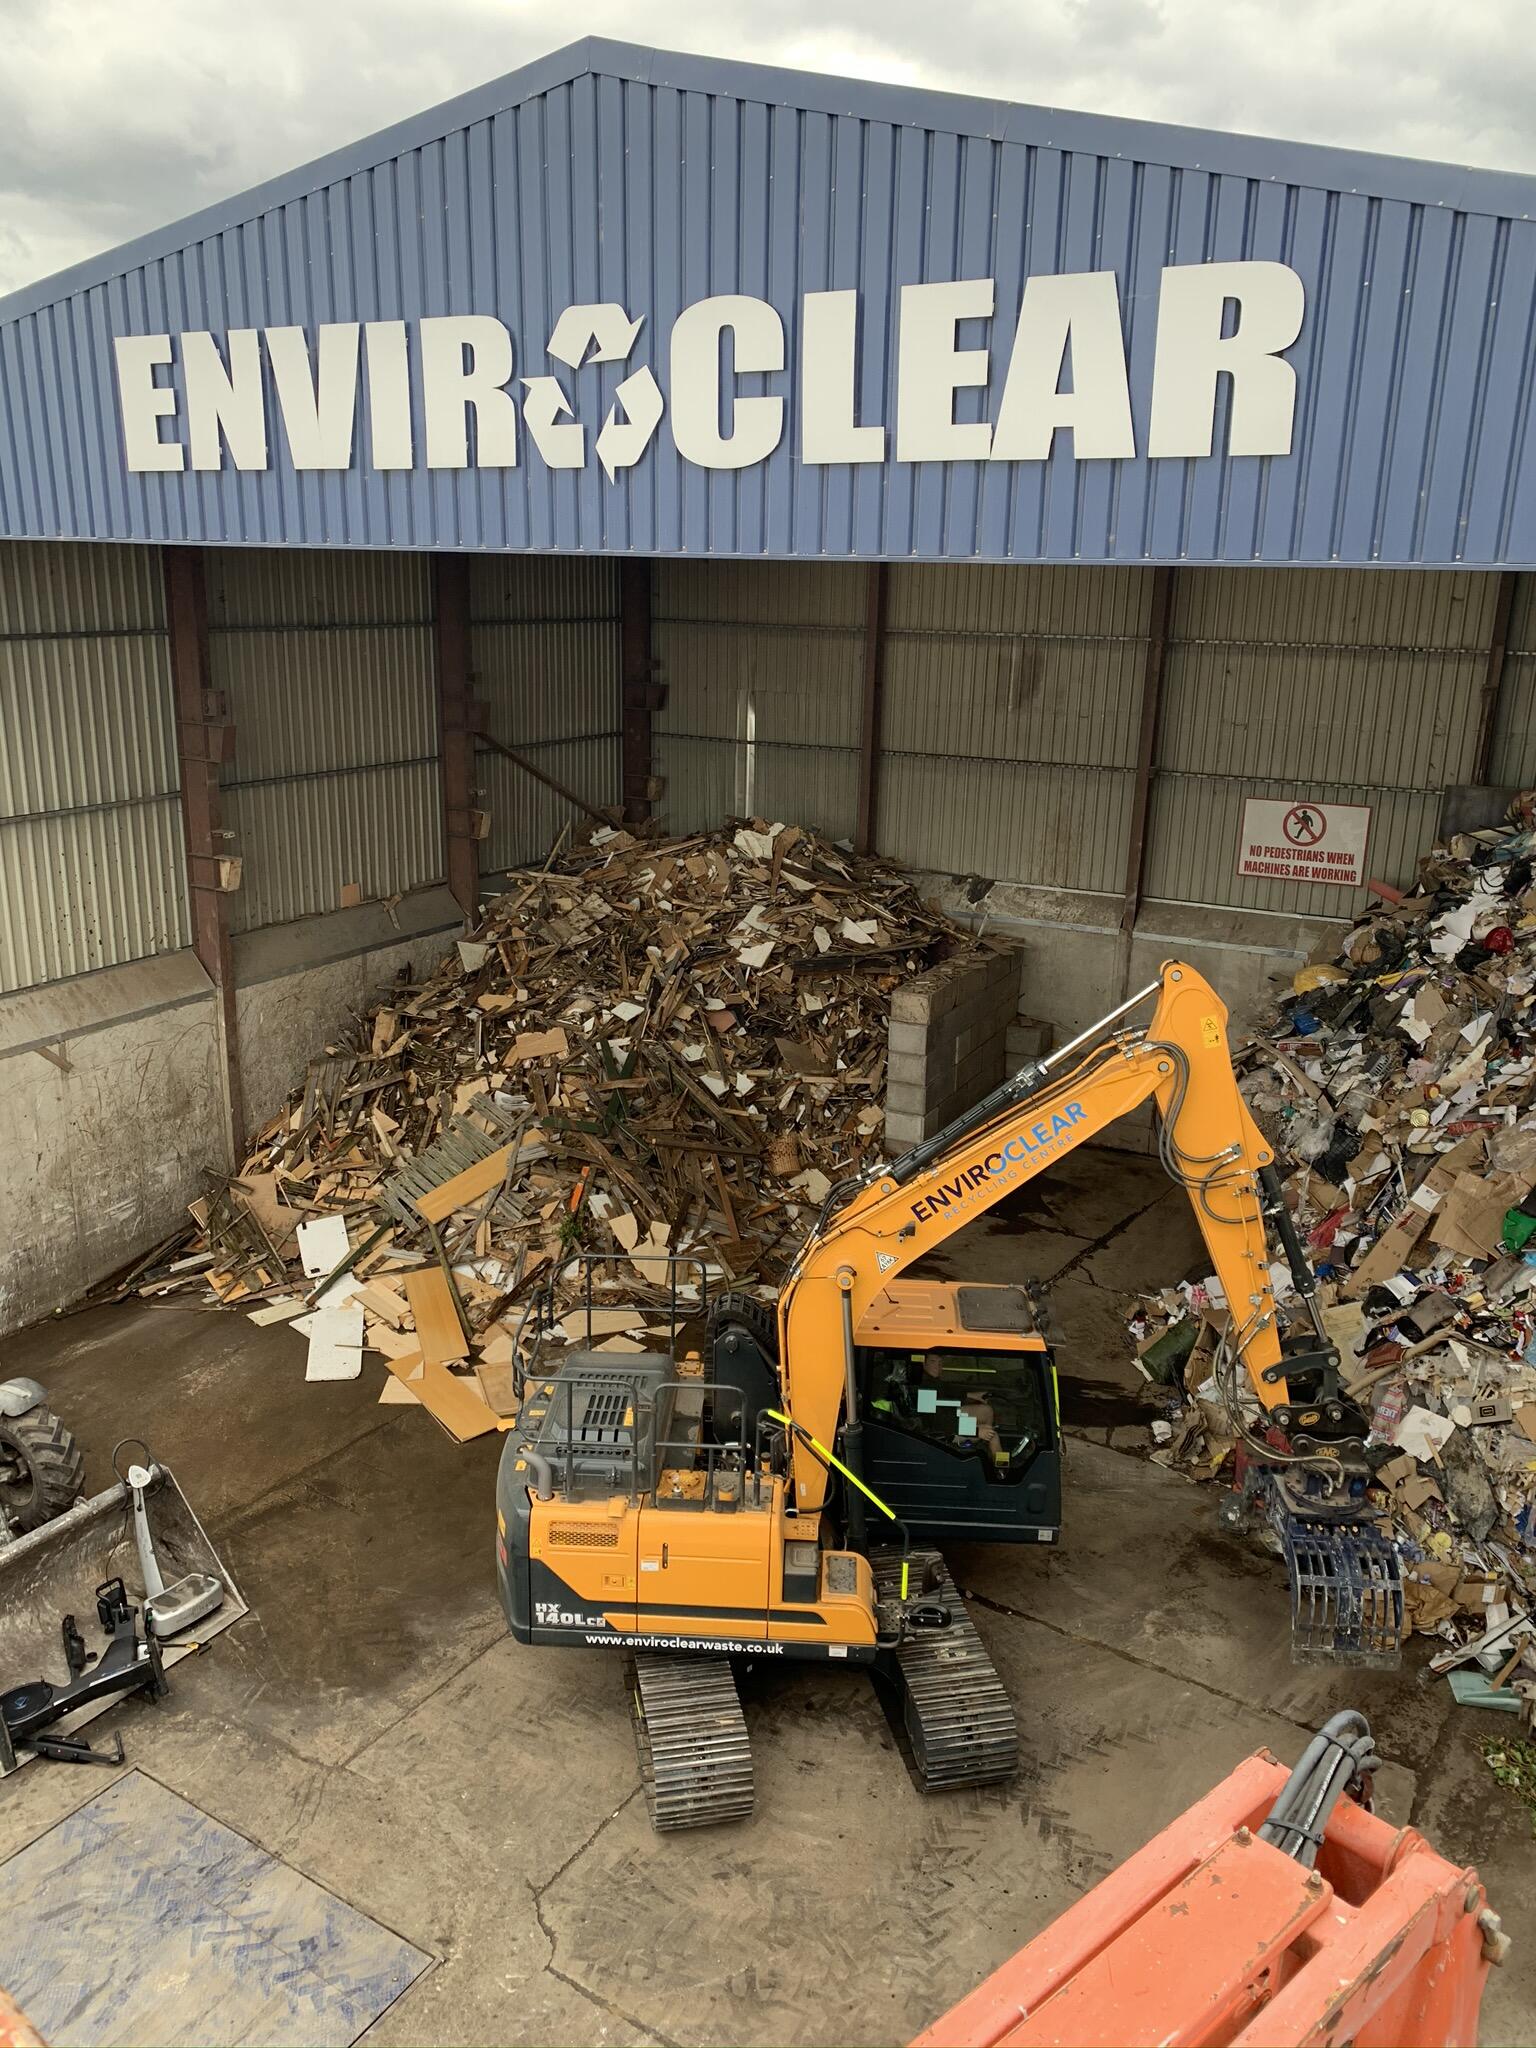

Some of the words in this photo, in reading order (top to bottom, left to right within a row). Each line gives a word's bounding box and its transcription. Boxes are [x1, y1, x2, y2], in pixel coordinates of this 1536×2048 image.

[1249, 845, 1262, 857] NO
[1264, 846, 1325, 863] PEDESTRIANS
[1327, 851, 1355, 866] WHEN
[1243, 860, 1291, 876] MACHINES
[1292, 864, 1310, 878] ARE
[1311, 866, 1357, 882] WORKING
[910, 1102, 1088, 1223] ENVIROCLEAR
[943, 1170, 1018, 1220] RECYCLING
[1022, 1133, 1075, 1170] CENTRE
[535, 1603, 561, 1613] HX
[585, 1634, 784, 1655] www.enviroclearwaste.co.uk
